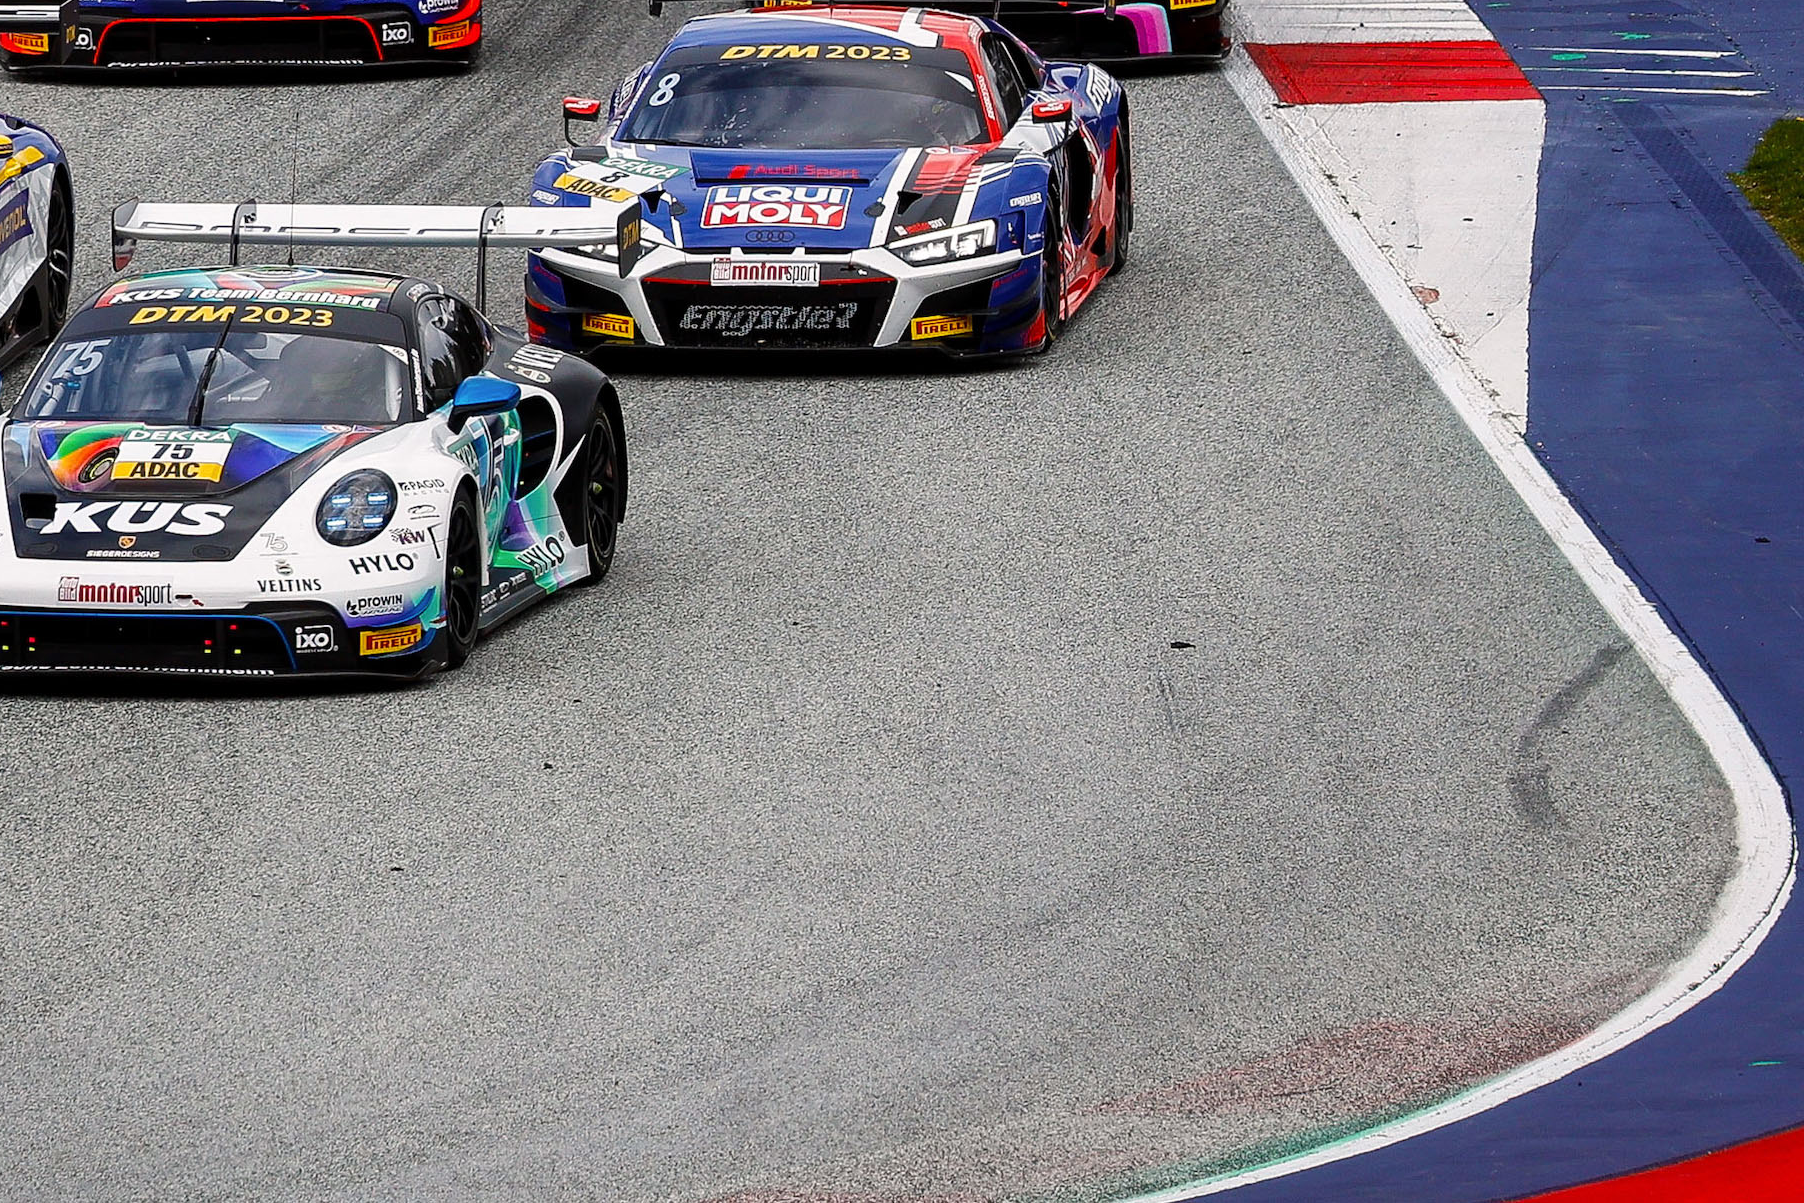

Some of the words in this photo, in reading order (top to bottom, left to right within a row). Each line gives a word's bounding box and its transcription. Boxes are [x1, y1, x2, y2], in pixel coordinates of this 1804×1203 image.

[382, 24, 407, 42] ixo
[432, 23, 468, 44] PIRELLI
[719, 45, 820, 60] DTM
[825, 45, 913, 61] 2023
[648, 72, 681, 107] 8
[599, 171, 630, 183] 8
[601, 157, 679, 178] DEKRA
[752, 164, 800, 176] Audi
[804, 165, 861, 179] Sport
[566, 177, 621, 199] ADAC
[713, 186, 845, 204] LIQUI
[709, 203, 846, 226] MOLY
[621, 217, 640, 249] DTM
[731, 261, 819, 285] motorsport
[109, 287, 185, 305] KÜS
[187, 286, 256, 299] Team
[257, 288, 380, 308] Bernhard
[128, 305, 237, 325] DTM
[239, 305, 334, 327] 2023
[584, 314, 632, 335] PIRELLI
[915, 317, 970, 337] PIRELLI
[54, 338, 112, 376] 75
[124, 428, 233, 443] DEKRA
[151, 442, 196, 461] 75
[127, 462, 201, 480] ADAC
[409, 478, 446, 489] PAGID
[39, 499, 235, 536] KÜS
[259, 532, 290, 552] 75
[85, 550, 160, 558] SIEGERDESIGNS
[78, 581, 173, 607] motorsport
[257, 578, 322, 593] VELTINS
[296, 626, 330, 648] ixo
[366, 627, 421, 652] PIRELLI
